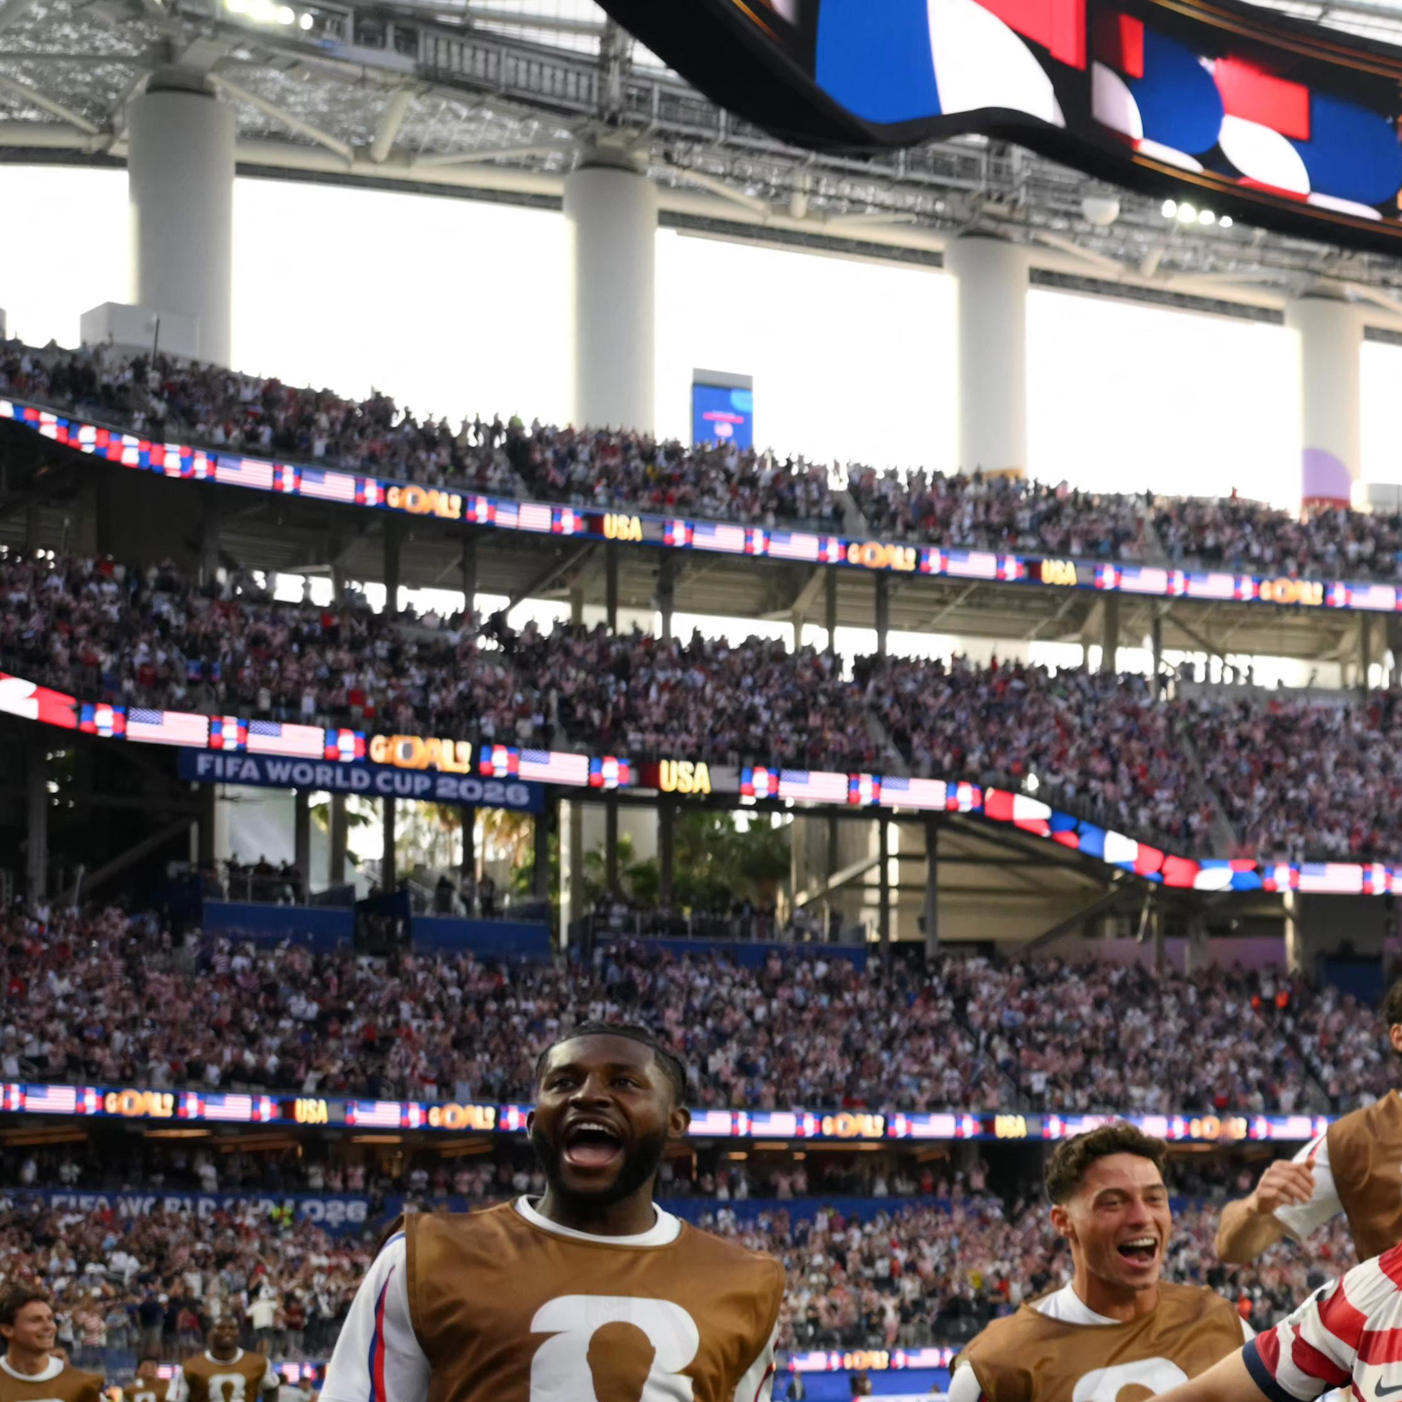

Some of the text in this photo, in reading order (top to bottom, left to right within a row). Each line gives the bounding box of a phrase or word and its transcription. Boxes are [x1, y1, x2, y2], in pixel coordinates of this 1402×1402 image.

[603, 513, 643, 541] USA
[196, 754, 530, 806] FIFA WORLD CUP 2026
[659, 760, 711, 794] USA
